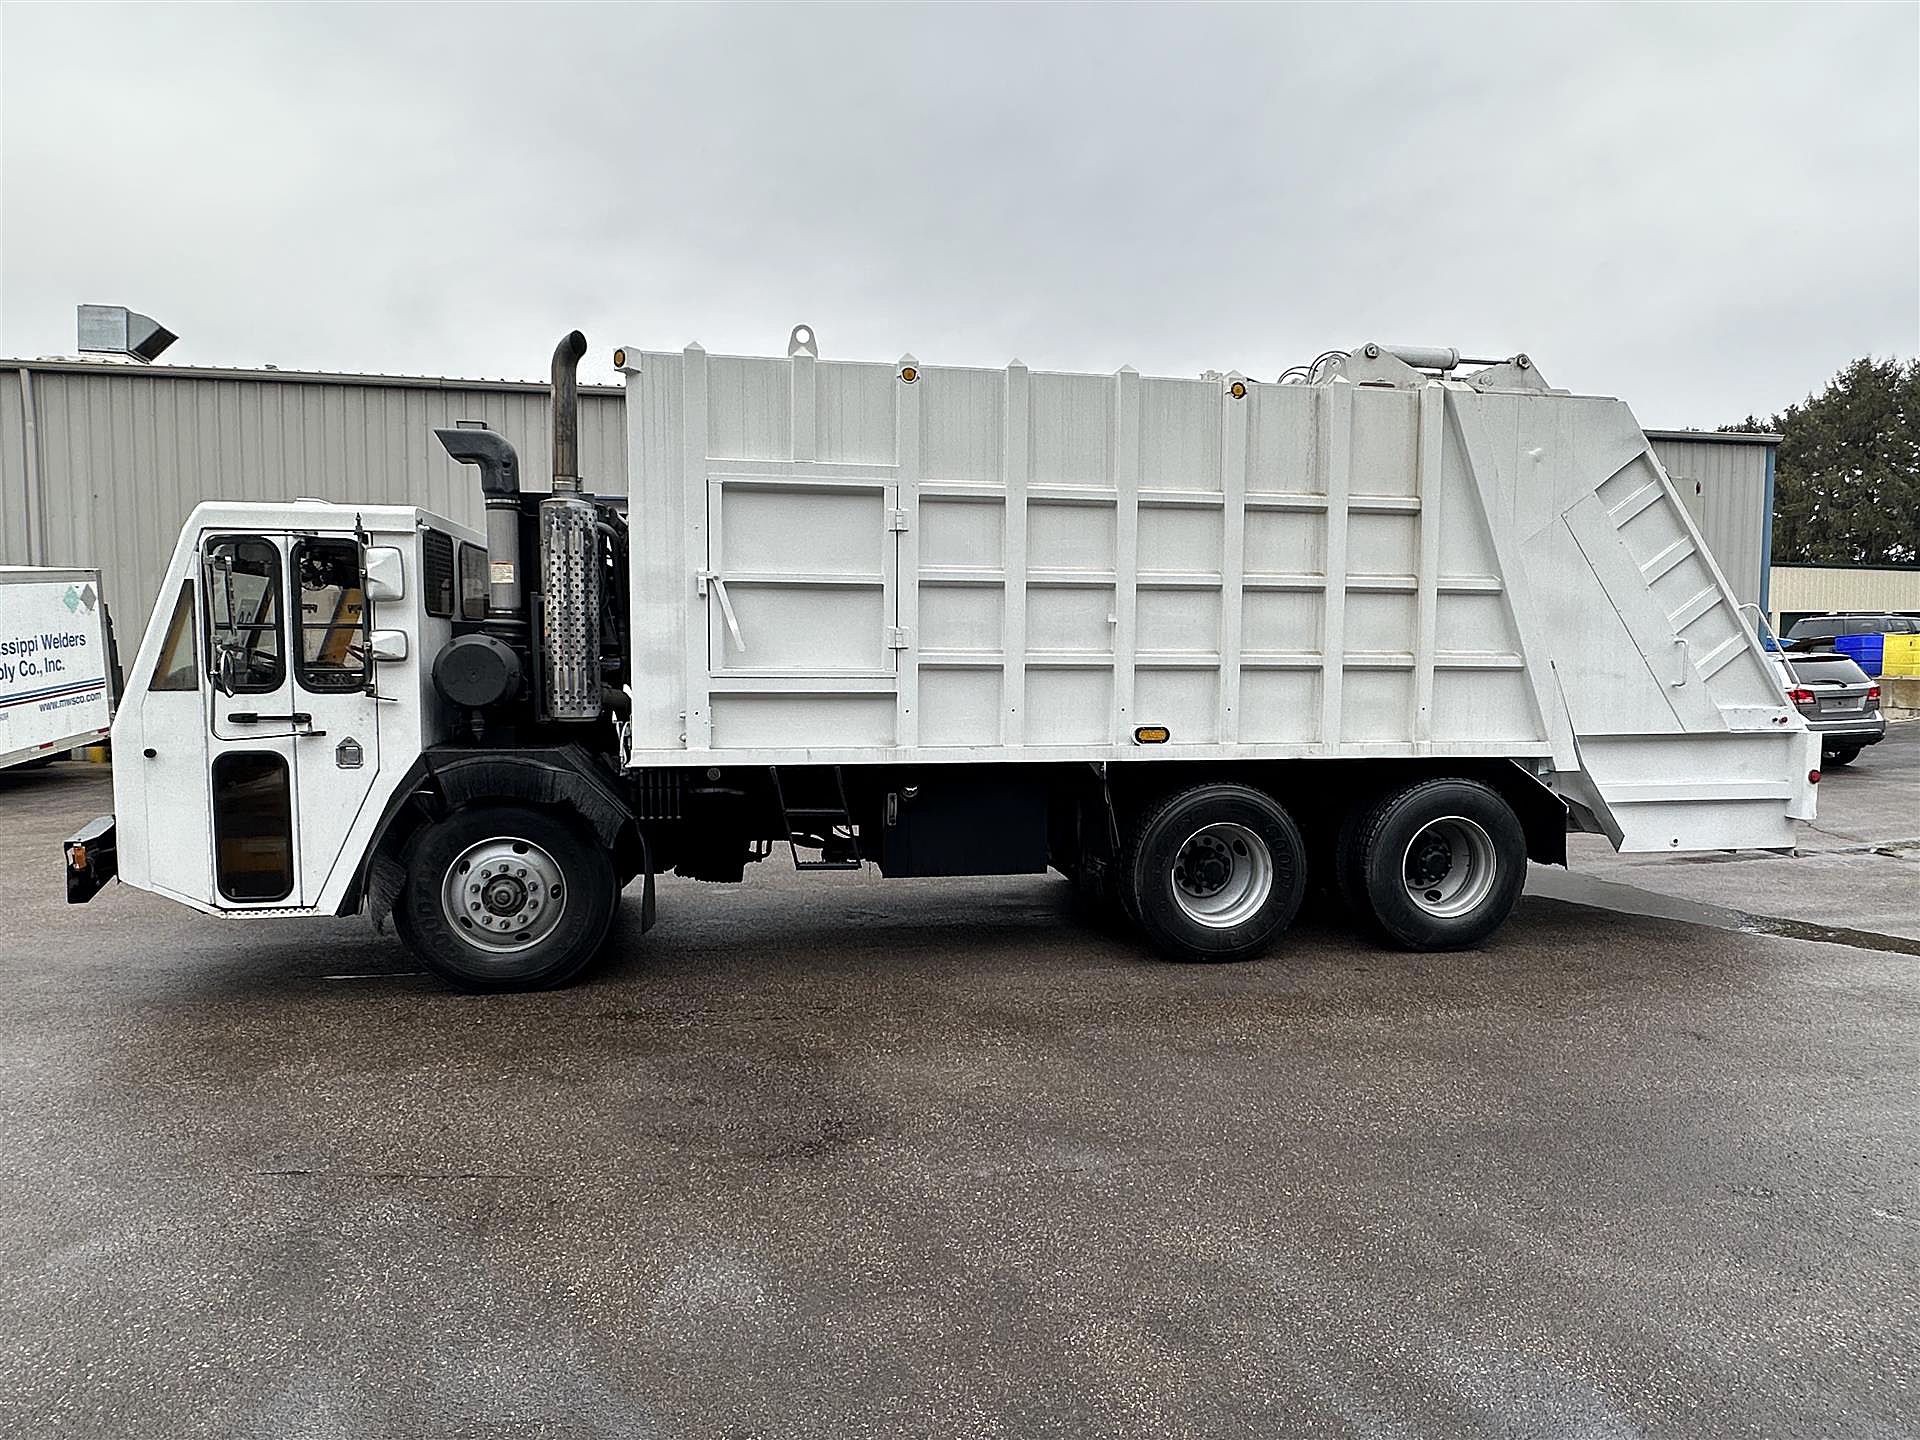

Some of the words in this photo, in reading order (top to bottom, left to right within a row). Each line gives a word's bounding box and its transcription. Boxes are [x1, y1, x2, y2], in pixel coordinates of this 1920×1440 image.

[40, 632, 86, 650] Welders
[19, 660, 43, 677] Co.,
[44, 657, 65, 673] Inc.
